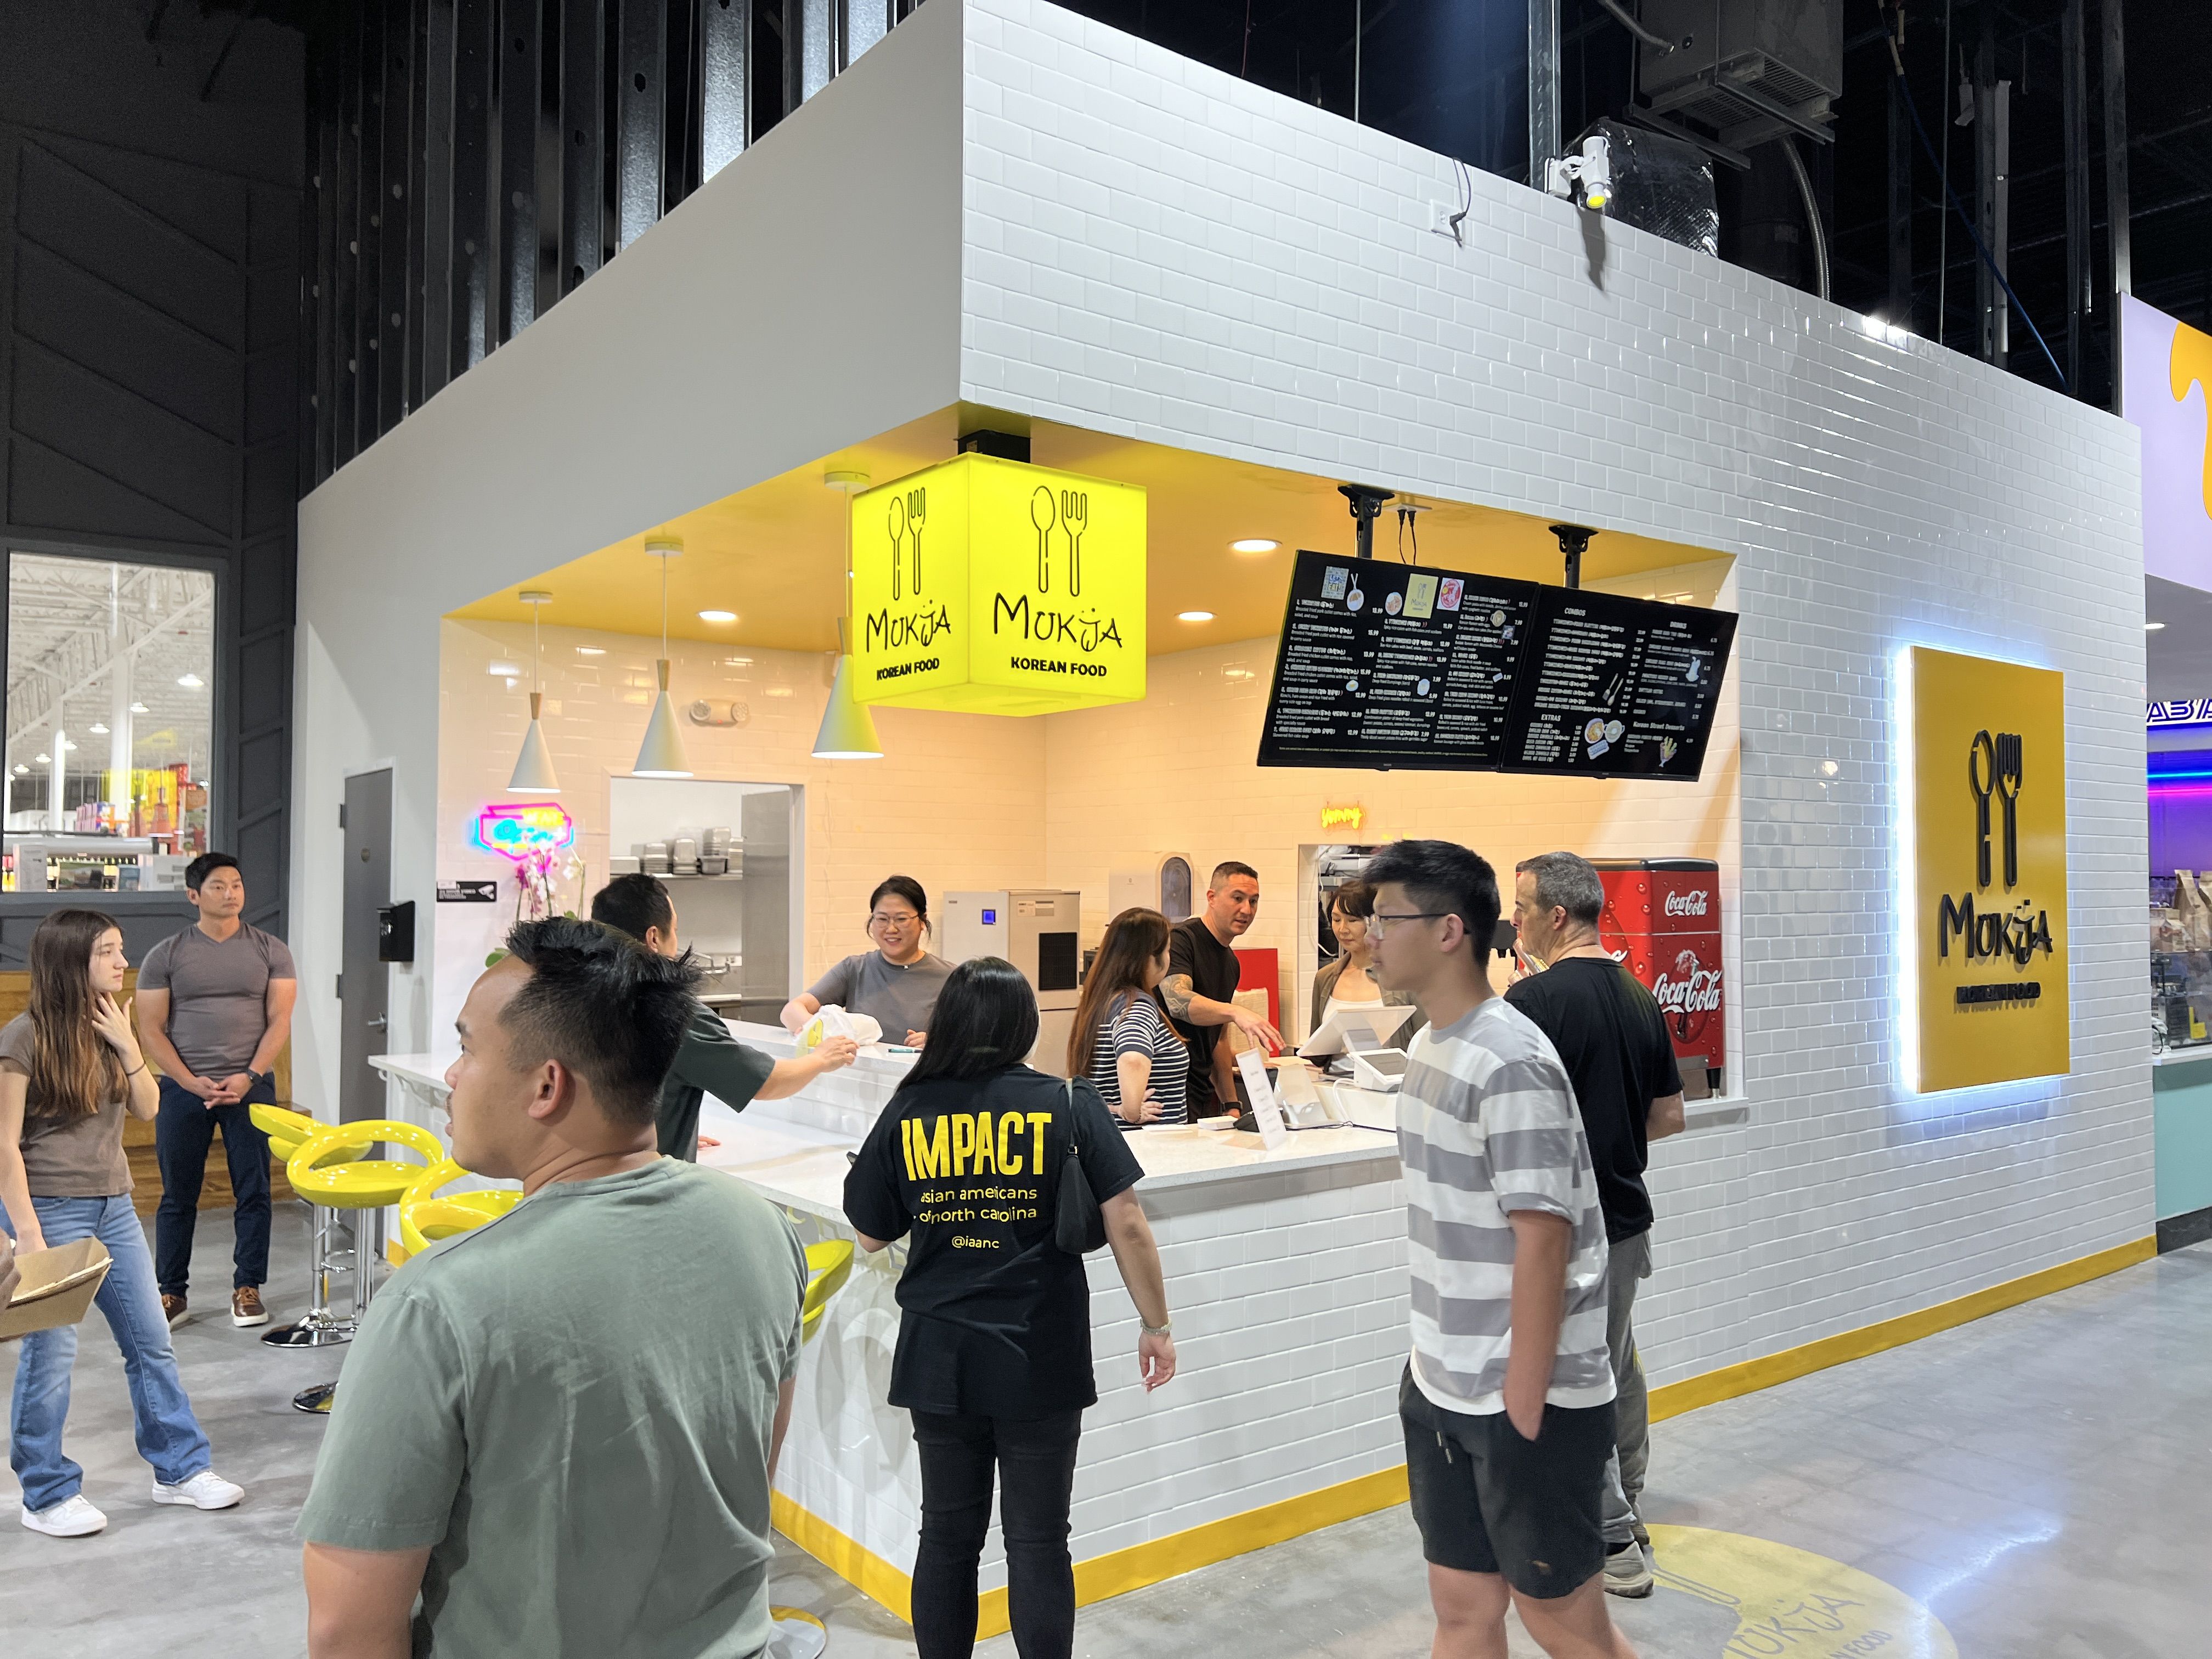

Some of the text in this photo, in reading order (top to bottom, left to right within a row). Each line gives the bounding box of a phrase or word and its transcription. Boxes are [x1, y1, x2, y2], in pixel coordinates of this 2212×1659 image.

[994, 592, 1122, 652] MUKJA
[1565, 607, 1586, 616] COMBOS
[877, 658, 940, 680] KOREAN FOOD
[1011, 657, 1107, 677] KOREAN FOOD
[1665, 890, 1708, 916] Coca-Cola
[1938, 892, 2053, 964] MUKJA
[1652, 969, 1722, 1013] Coca-Cola
[901, 1111, 1052, 1181] IMPACT
[921, 1189, 955, 1203] asian
[919, 1210, 932, 1222] of
[932, 1208, 974, 1224] north
[951, 1235, 1000, 1249] @iaanc
[1723, 1594, 1865, 1659] UKJA
